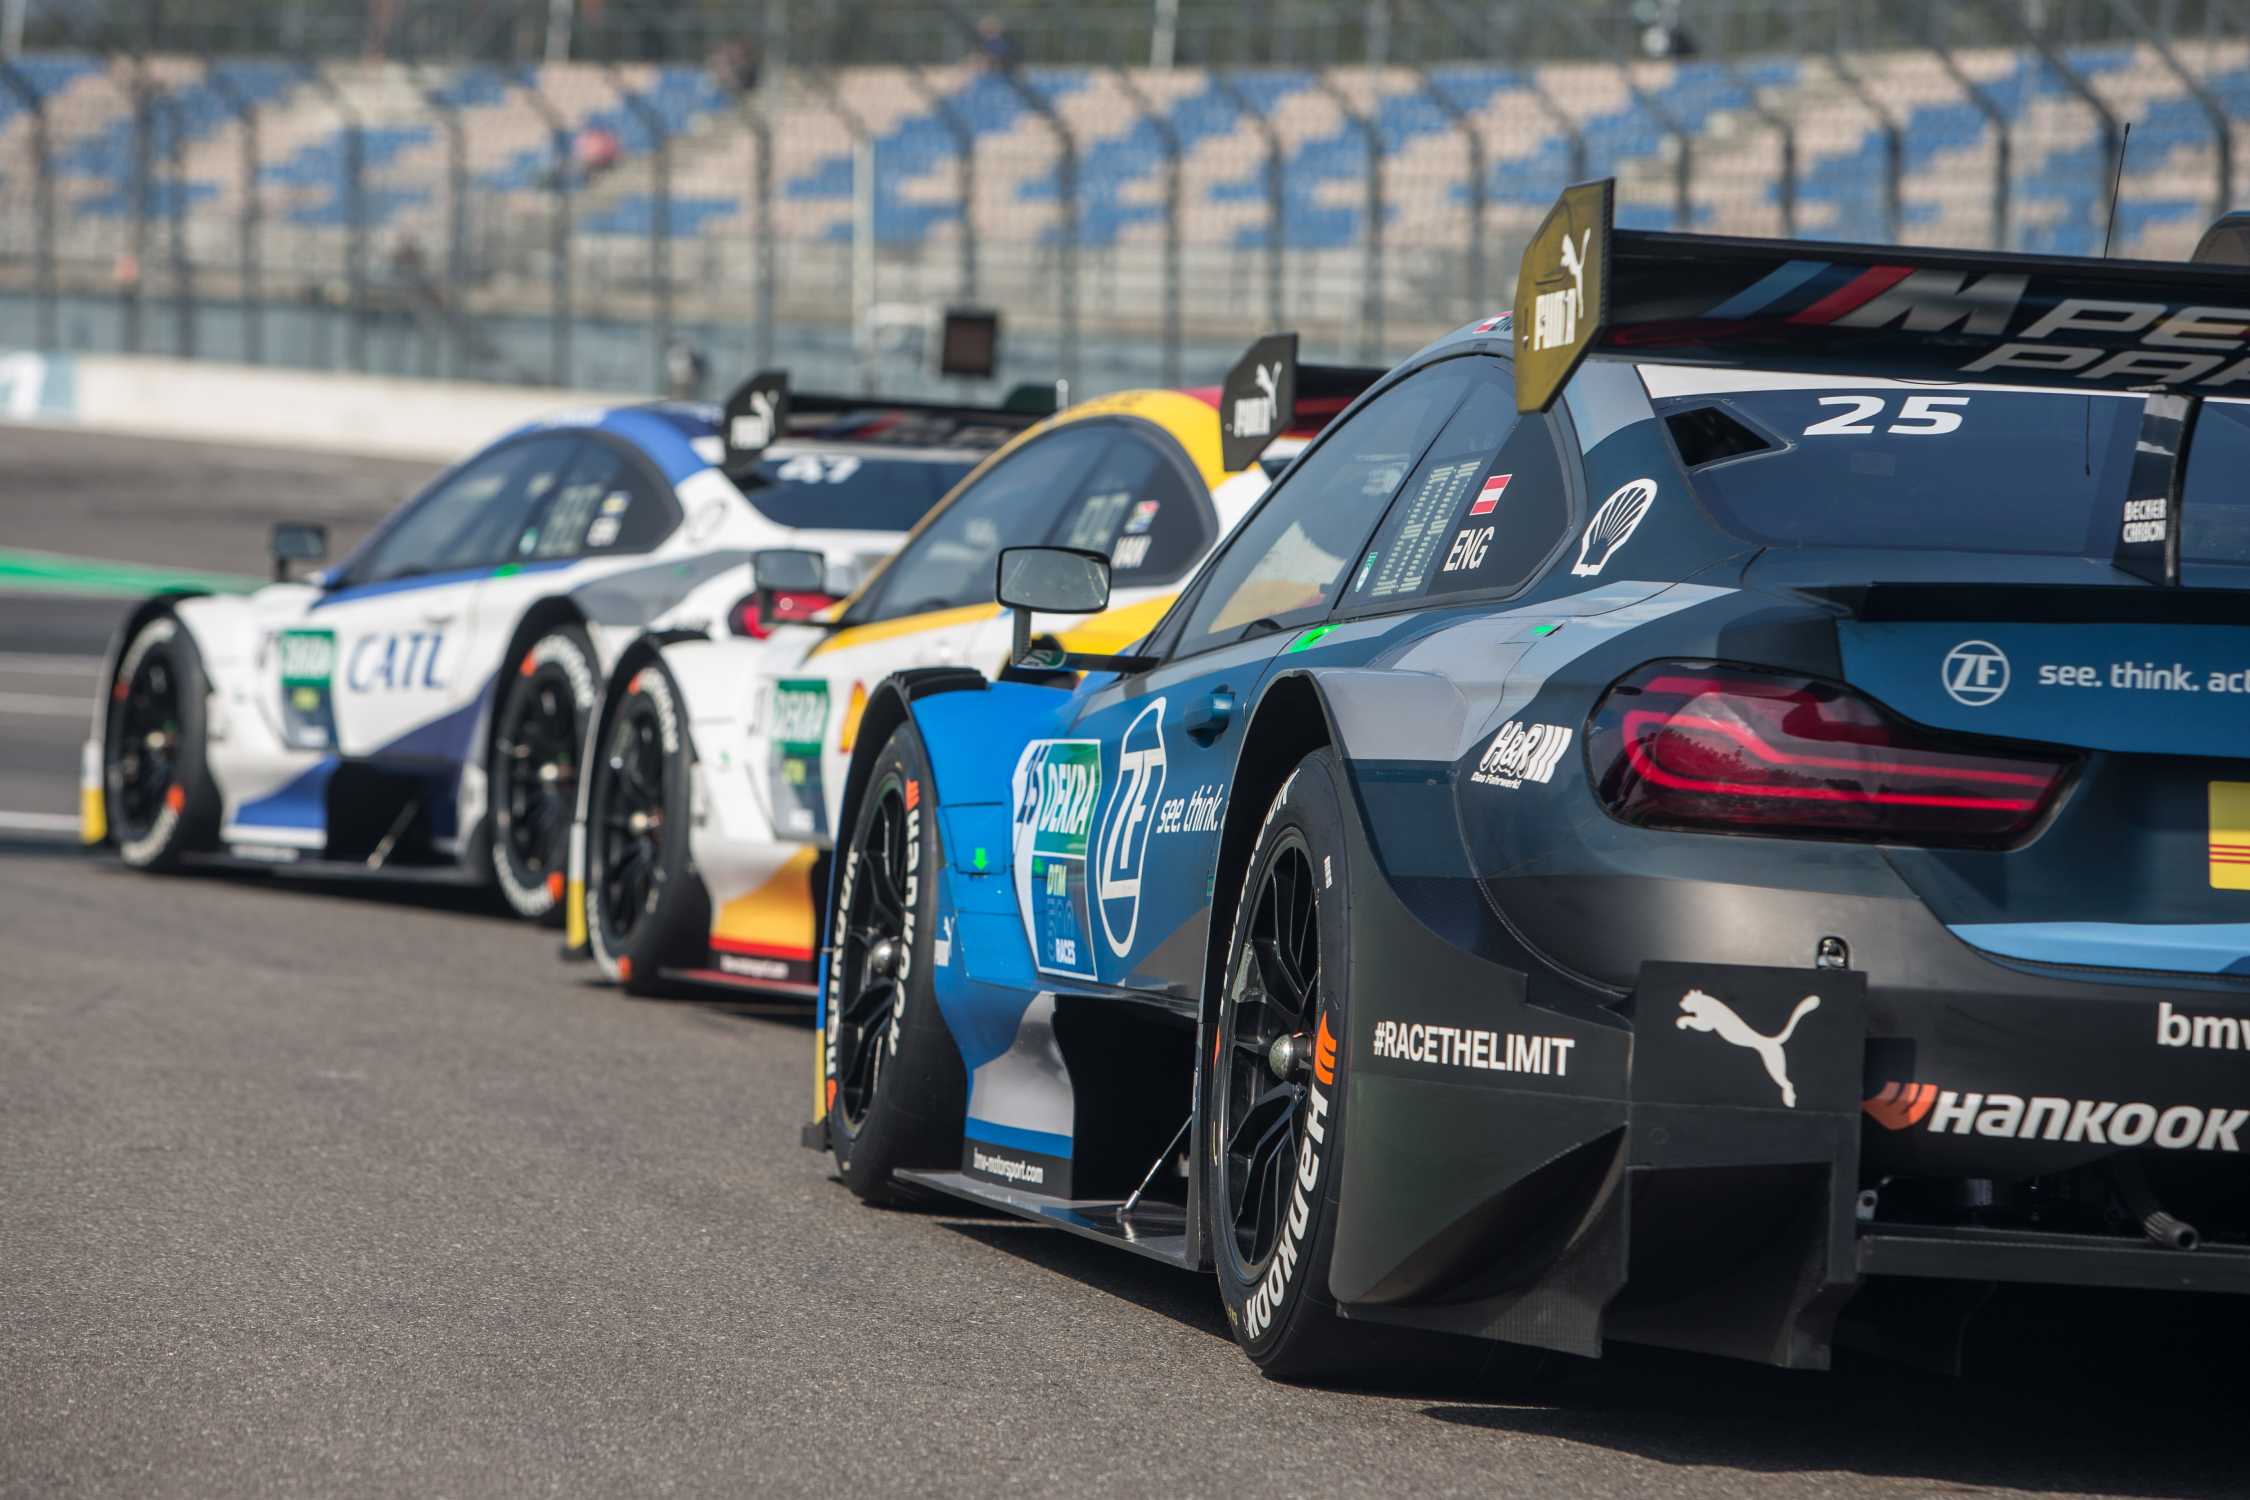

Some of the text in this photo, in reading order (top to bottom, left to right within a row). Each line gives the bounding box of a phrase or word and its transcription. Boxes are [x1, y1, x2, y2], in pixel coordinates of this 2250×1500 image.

[1803, 395, 1970, 436] 25
[1443, 526, 1496, 571] ENG
[1949, 653, 2004, 694] ZF
[2038, 664, 2102, 688] see.
[2110, 661, 2200, 692] think.
[1039, 763, 1096, 835] DEKRA
[1373, 1020, 1576, 1077] #RACETHELIMIT
